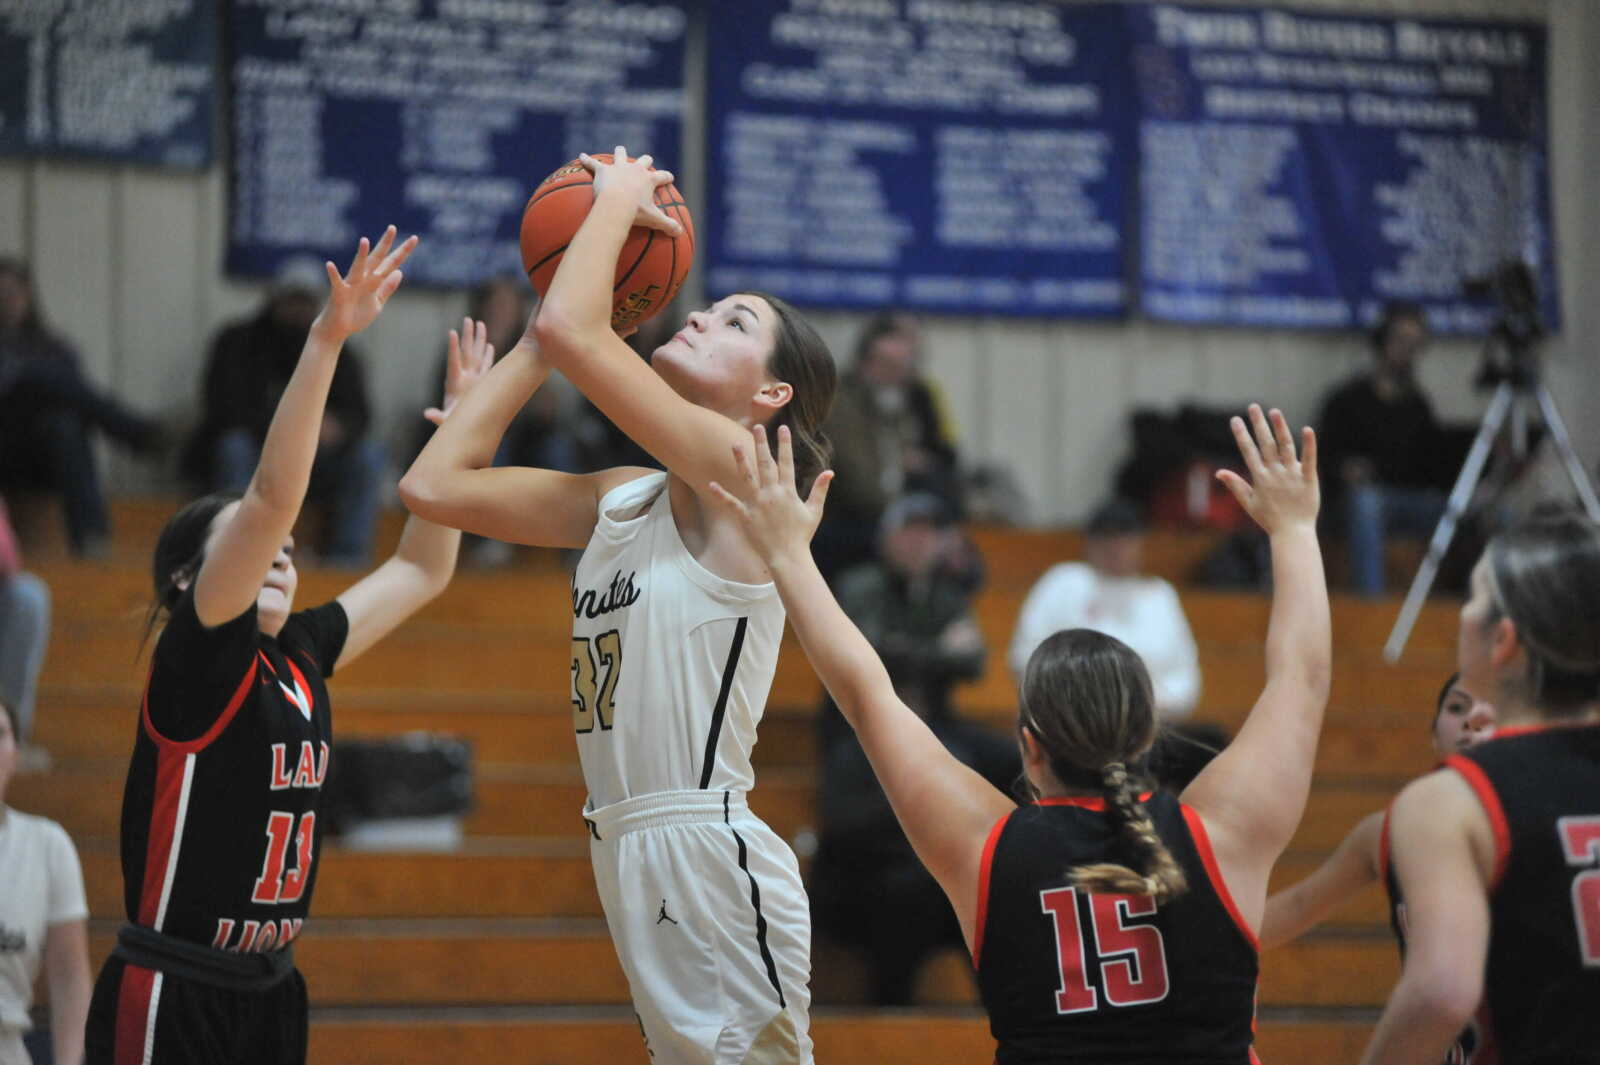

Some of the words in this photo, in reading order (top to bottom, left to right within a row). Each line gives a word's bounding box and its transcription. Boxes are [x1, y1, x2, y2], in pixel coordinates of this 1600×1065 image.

[571, 629, 623, 734] 32
[251, 810, 316, 904] 13
[1040, 885, 1170, 1014] 15
